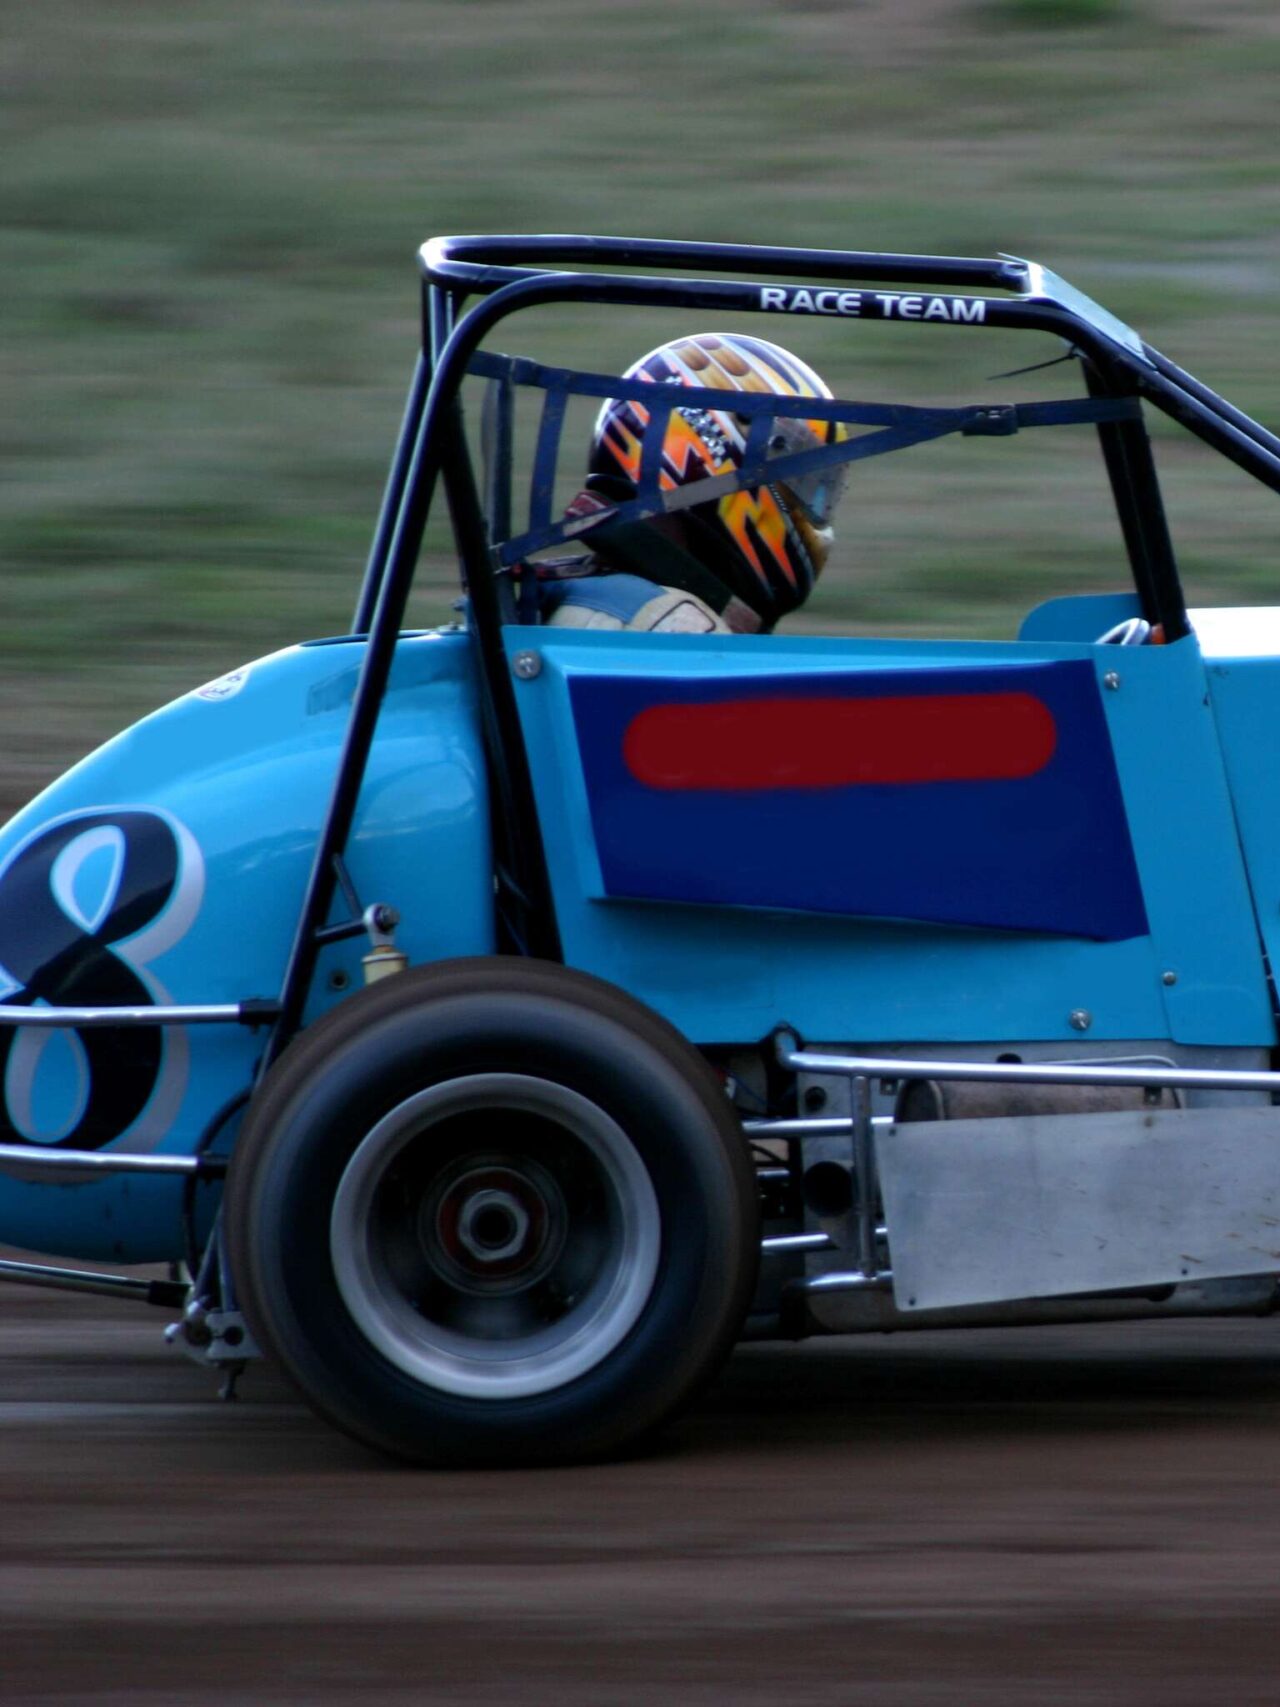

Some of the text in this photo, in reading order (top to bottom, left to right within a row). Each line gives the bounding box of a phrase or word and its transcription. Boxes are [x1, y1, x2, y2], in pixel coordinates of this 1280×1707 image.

[760, 287, 986, 322] RACE TEAM
[0, 806, 203, 1176] 8
